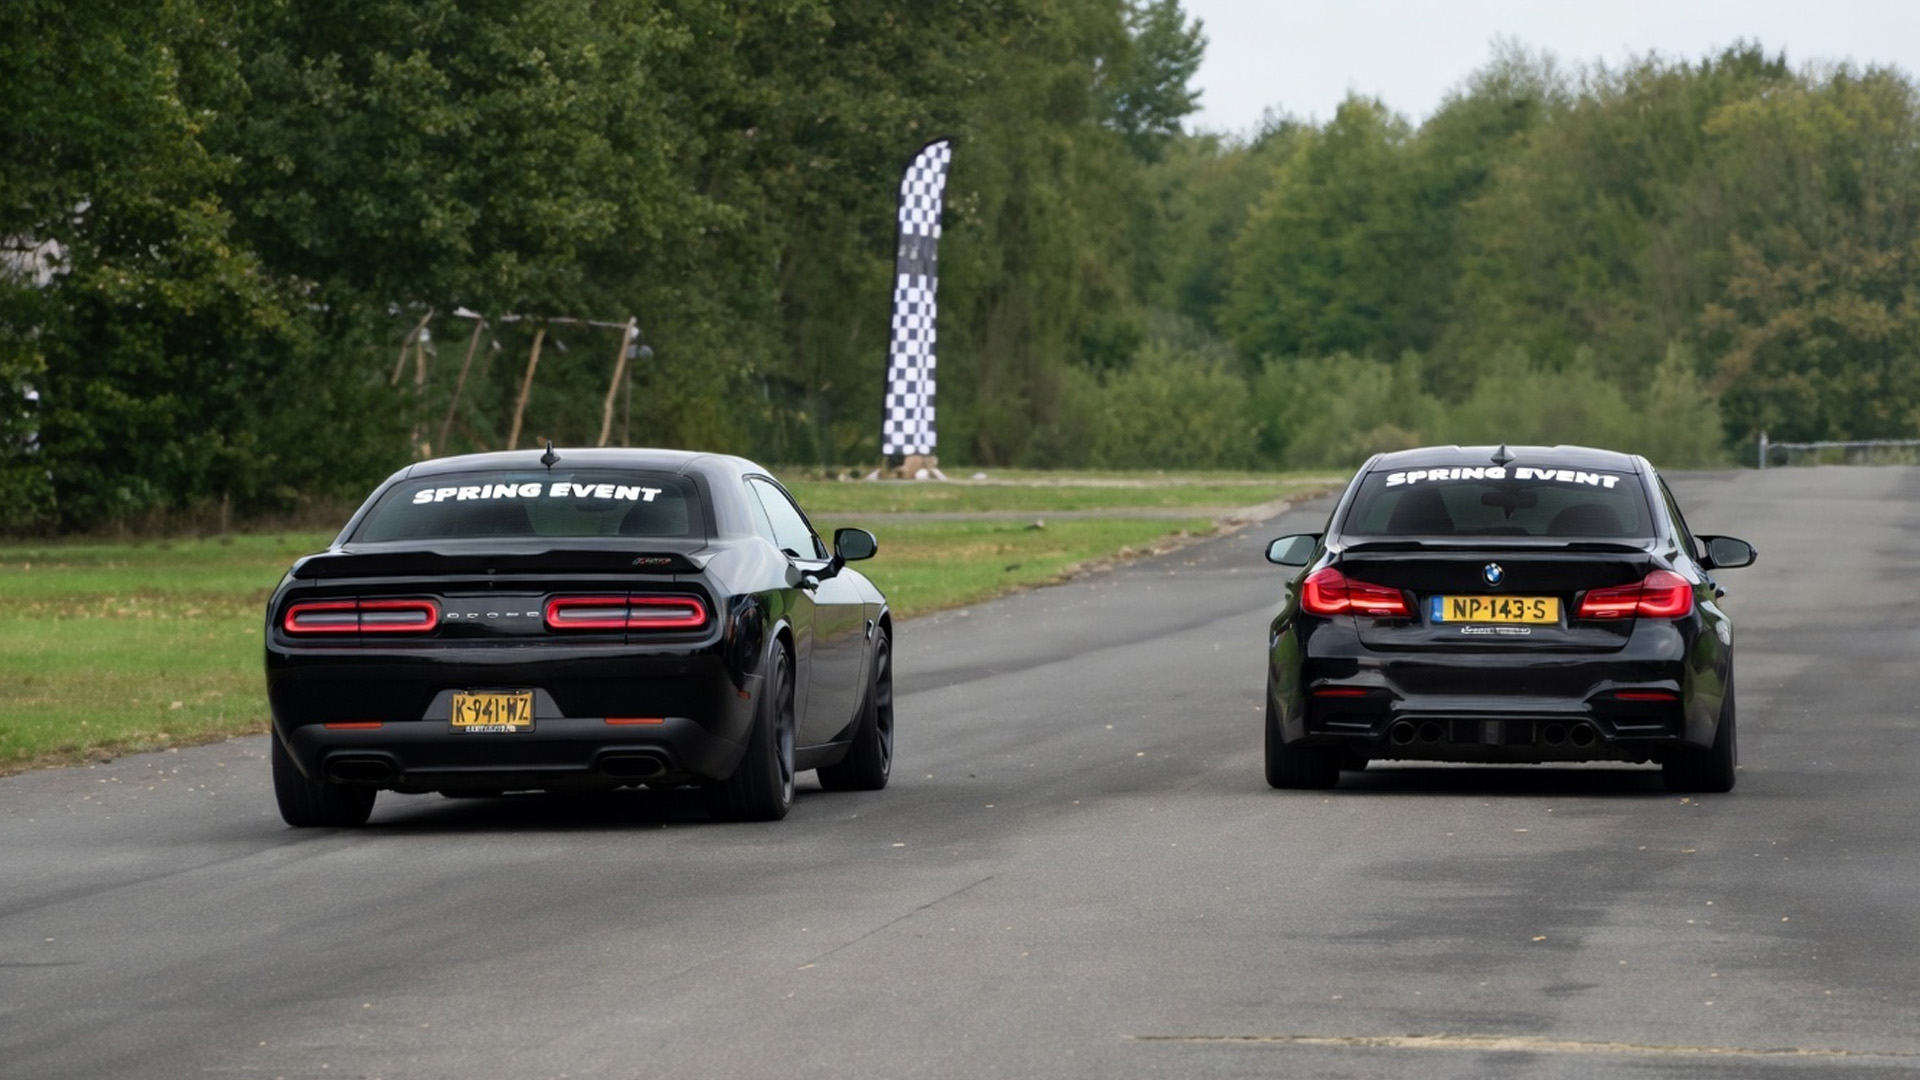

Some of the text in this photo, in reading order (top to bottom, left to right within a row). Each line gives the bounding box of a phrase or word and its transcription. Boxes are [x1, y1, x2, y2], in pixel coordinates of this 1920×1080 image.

[1386, 466, 1620, 488] SPRING EVENT
[412, 483, 662, 504] SPRING EVENT
